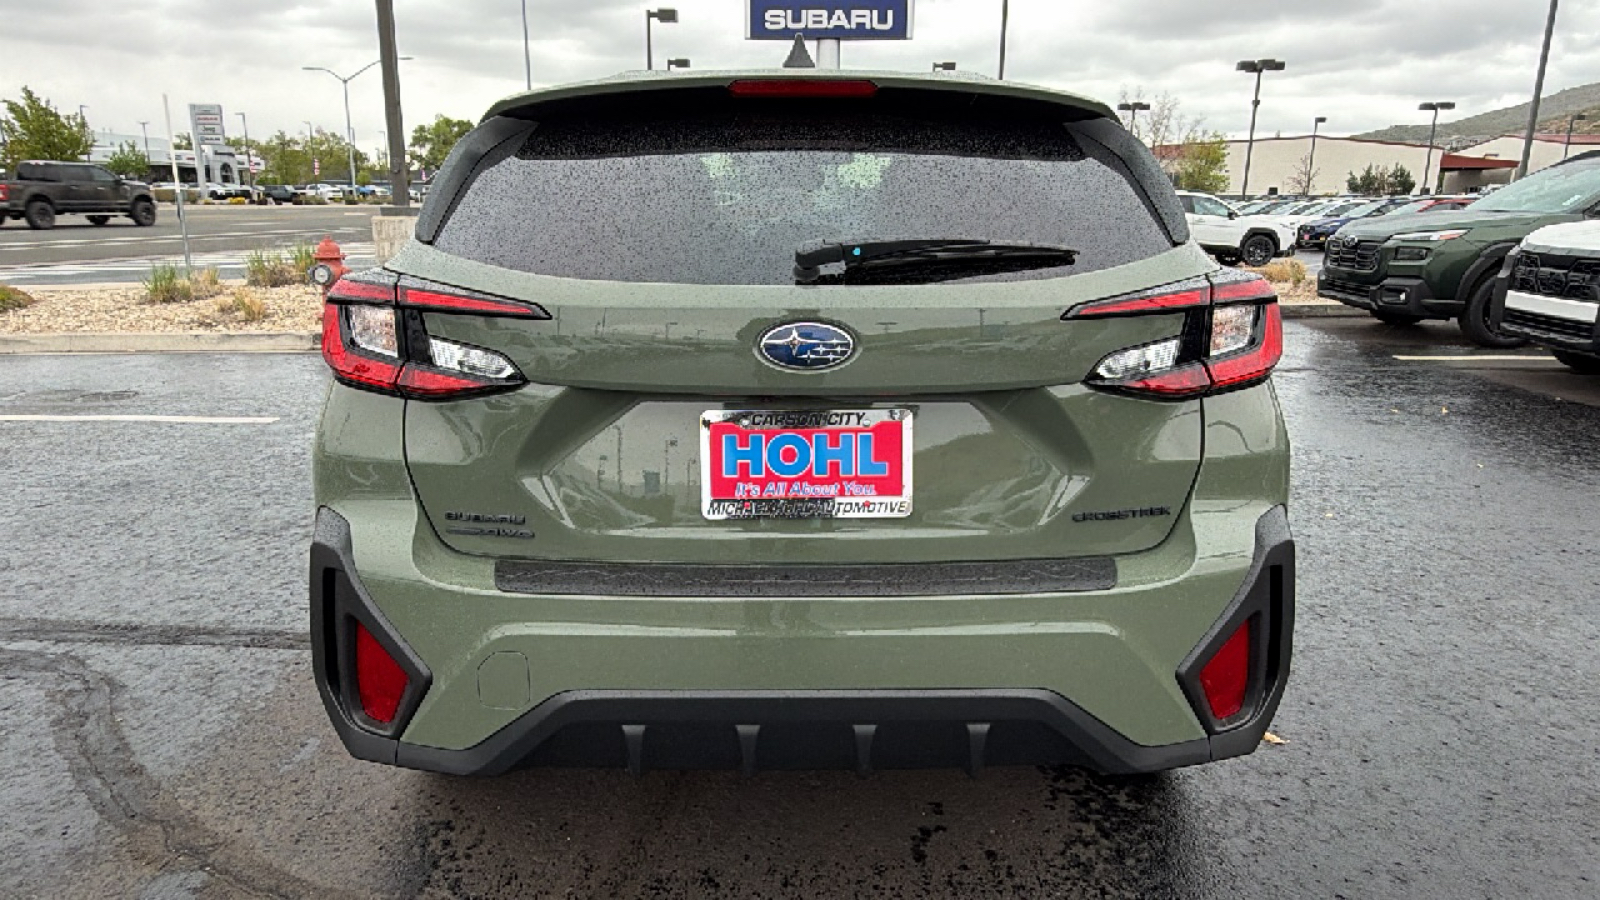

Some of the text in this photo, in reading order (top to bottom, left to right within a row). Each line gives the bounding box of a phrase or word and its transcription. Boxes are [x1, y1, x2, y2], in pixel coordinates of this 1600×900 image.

[764, 9, 893, 30] SUBARU
[752, 412, 866, 426] CARSON CITY
[722, 432, 889, 478] HOHL
[735, 482, 760, 496] It's
[763, 482, 786, 496] All
[789, 481, 840, 496] About
[444, 511, 526, 525] SUBARU
[1072, 506, 1170, 522] CROSSTREK
